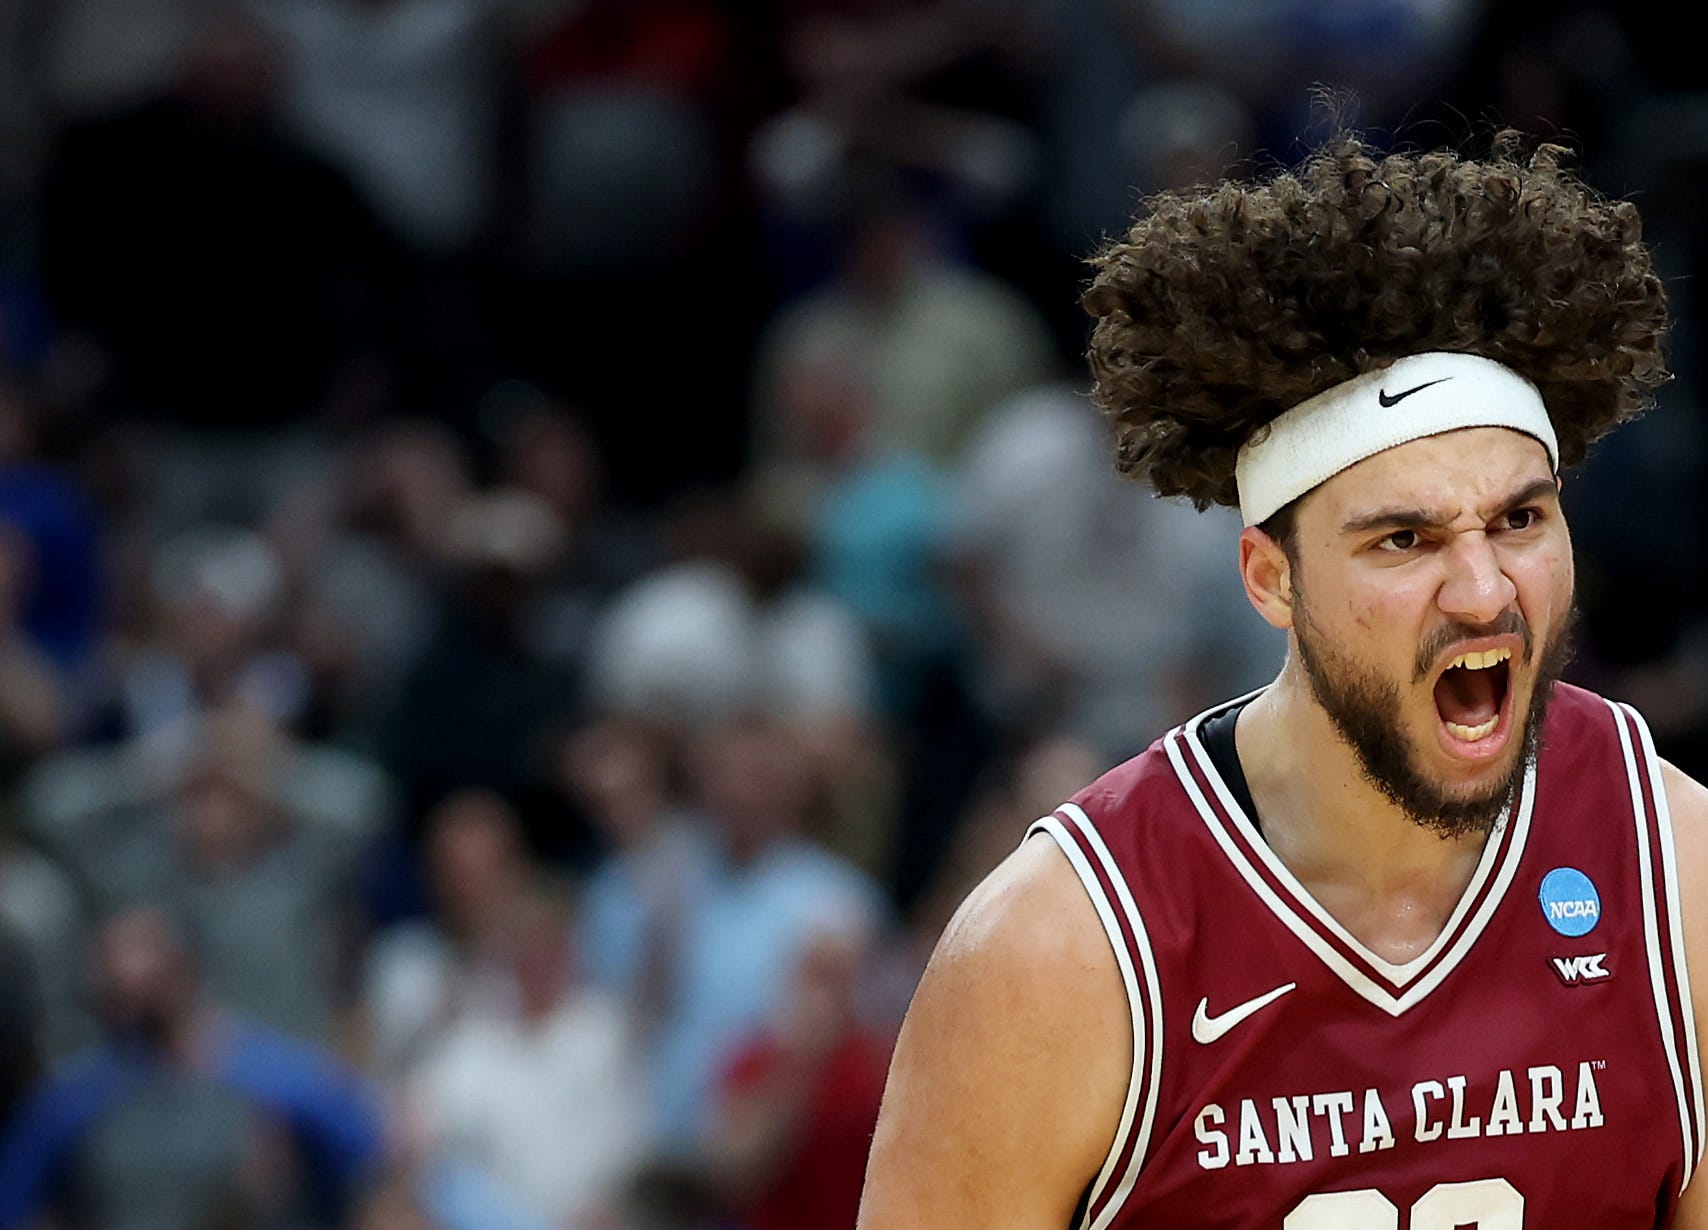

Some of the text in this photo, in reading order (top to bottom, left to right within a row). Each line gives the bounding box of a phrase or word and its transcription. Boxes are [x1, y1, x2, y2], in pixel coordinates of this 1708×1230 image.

[1549, 899, 1598, 919] NCAA
[1553, 953, 1610, 981] WCC
[1194, 1088, 1396, 1170] SANTA
[1411, 1061, 1604, 1143] CLARA
